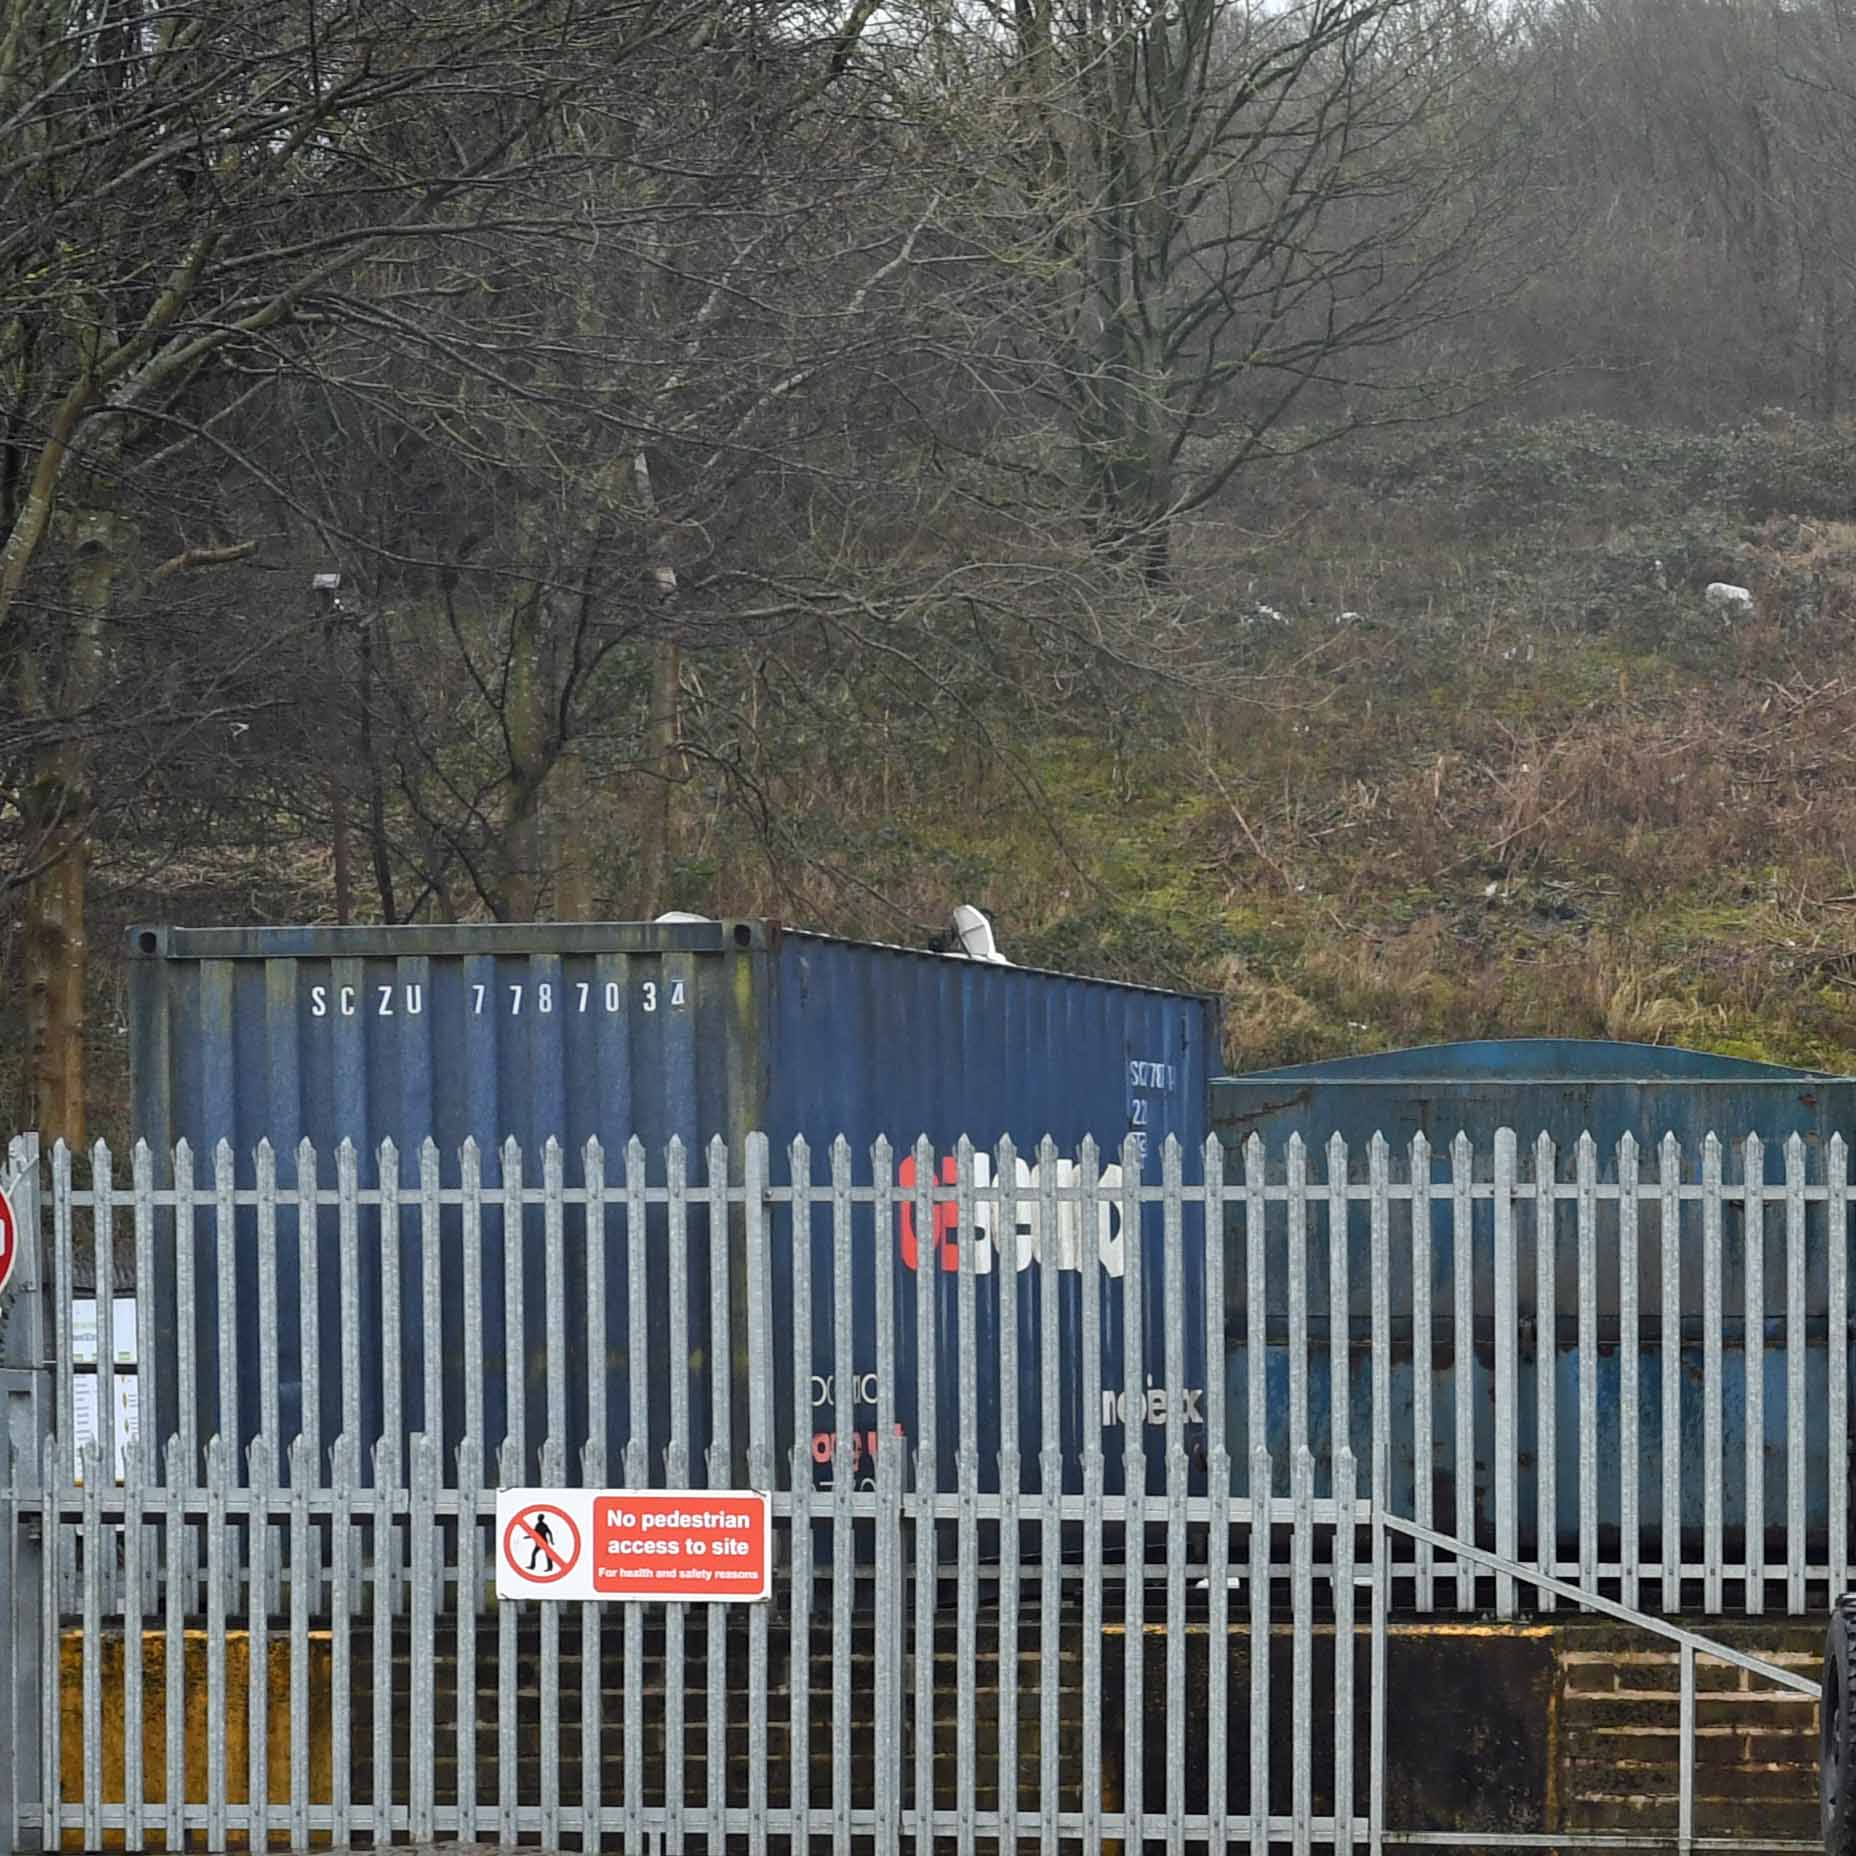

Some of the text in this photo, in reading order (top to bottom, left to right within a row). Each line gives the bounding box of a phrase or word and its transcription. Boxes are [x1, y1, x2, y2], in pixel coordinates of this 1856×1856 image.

[311, 984, 422, 1016] SCZU
[607, 1509, 751, 1532] No pedestrian
[607, 1537, 750, 1556] access to site
[598, 1567, 760, 1581] For health and safety reasons
